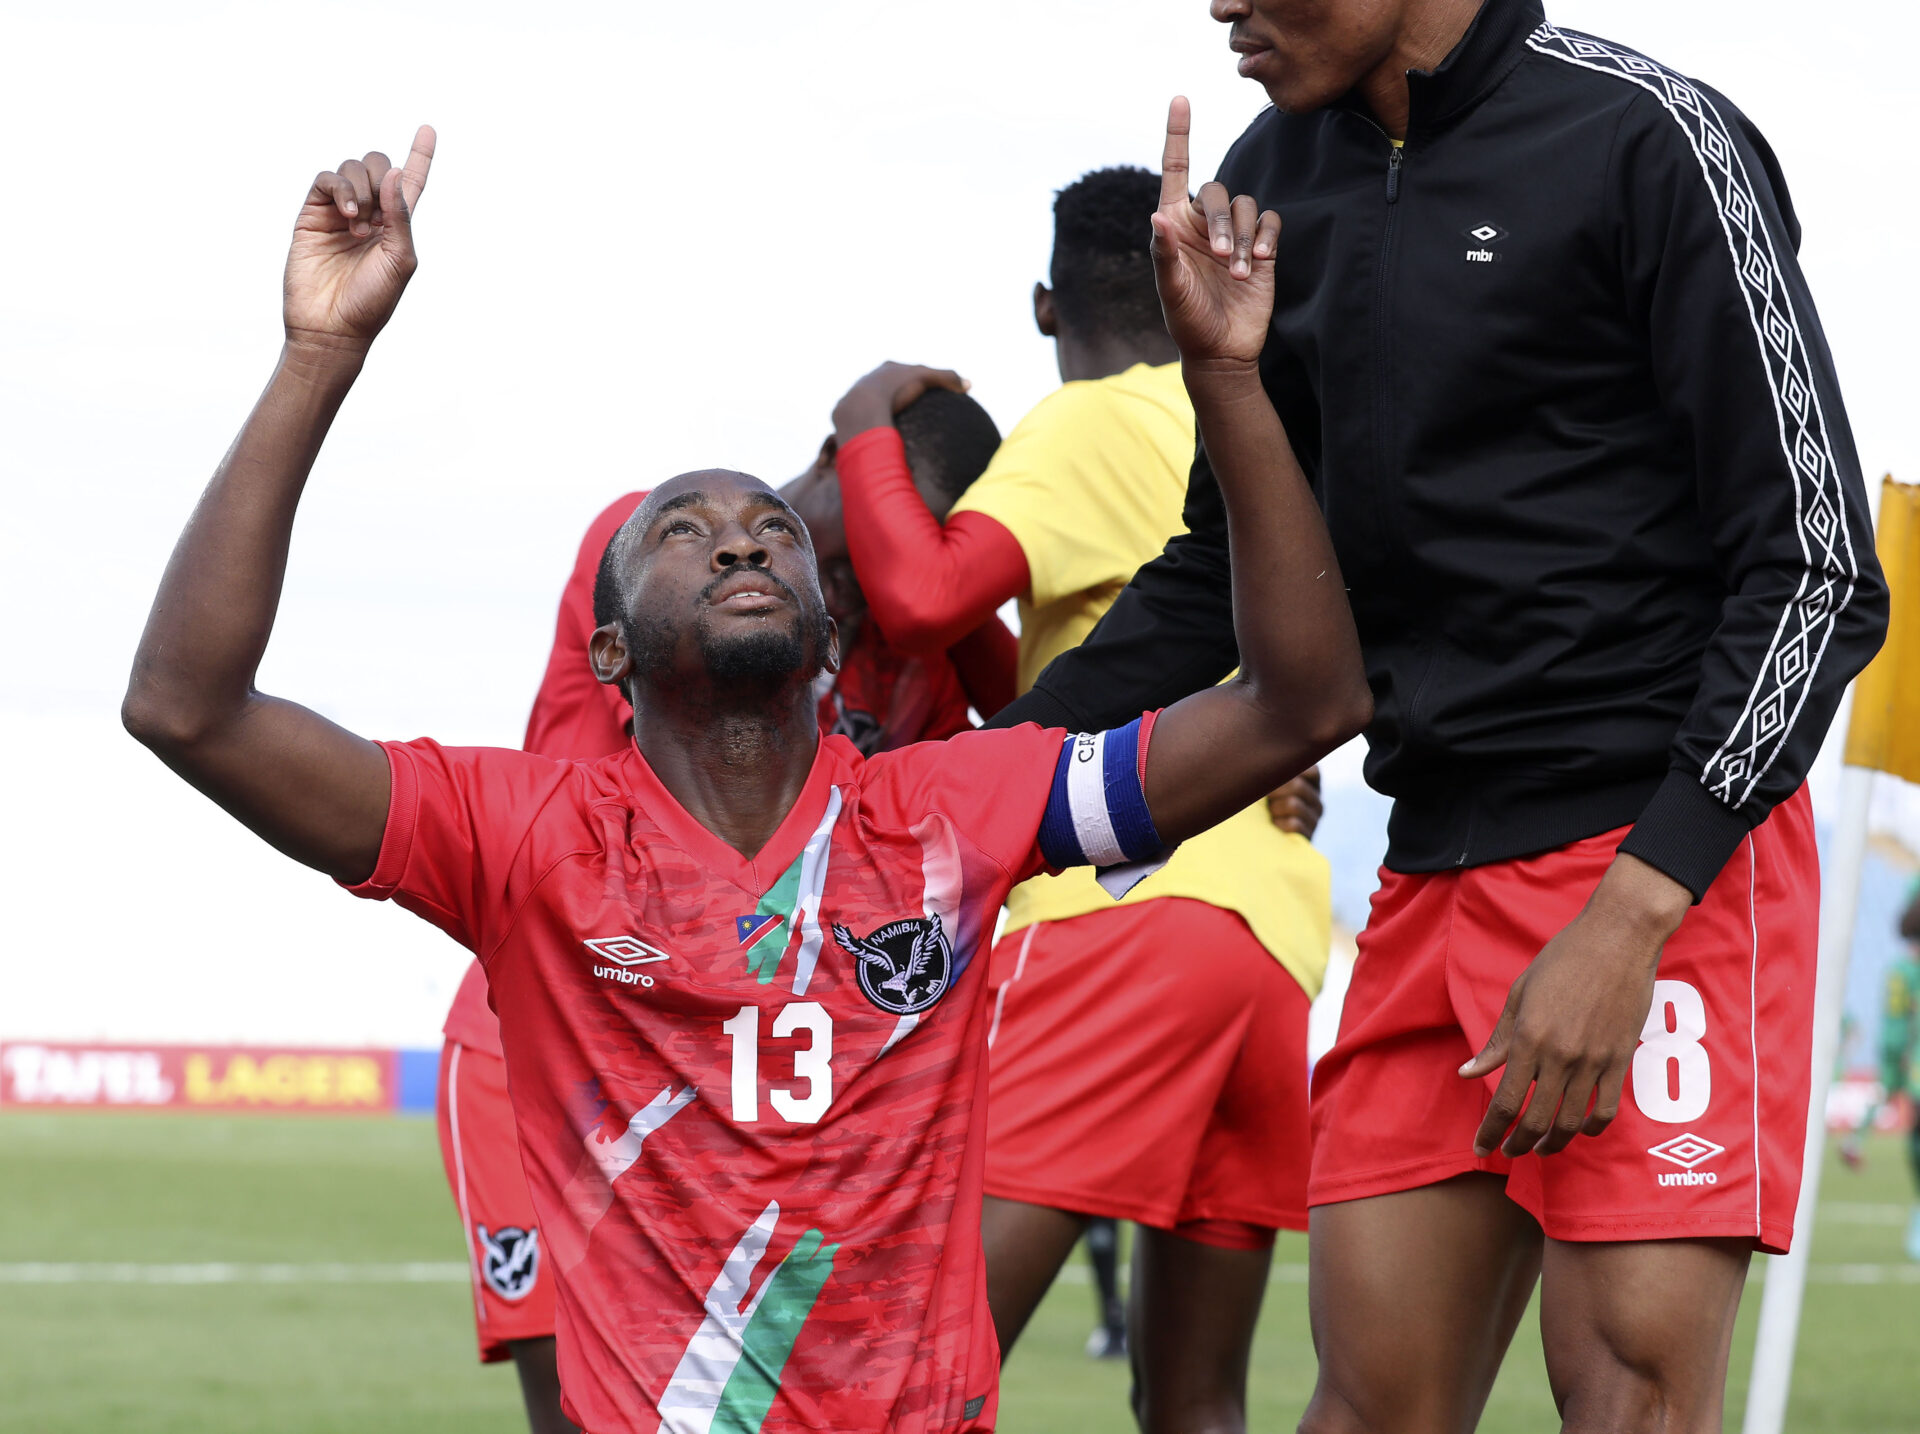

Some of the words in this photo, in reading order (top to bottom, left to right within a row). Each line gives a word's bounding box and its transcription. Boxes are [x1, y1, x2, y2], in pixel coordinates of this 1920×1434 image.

[870, 922, 922, 946] NAMIBIA
[593, 965, 655, 988] umbro
[722, 1001, 834, 1124] 13
[1631, 979, 1712, 1124] 8
[185, 1053, 383, 1104] LAGER
[1657, 1169, 1718, 1187] umbro
